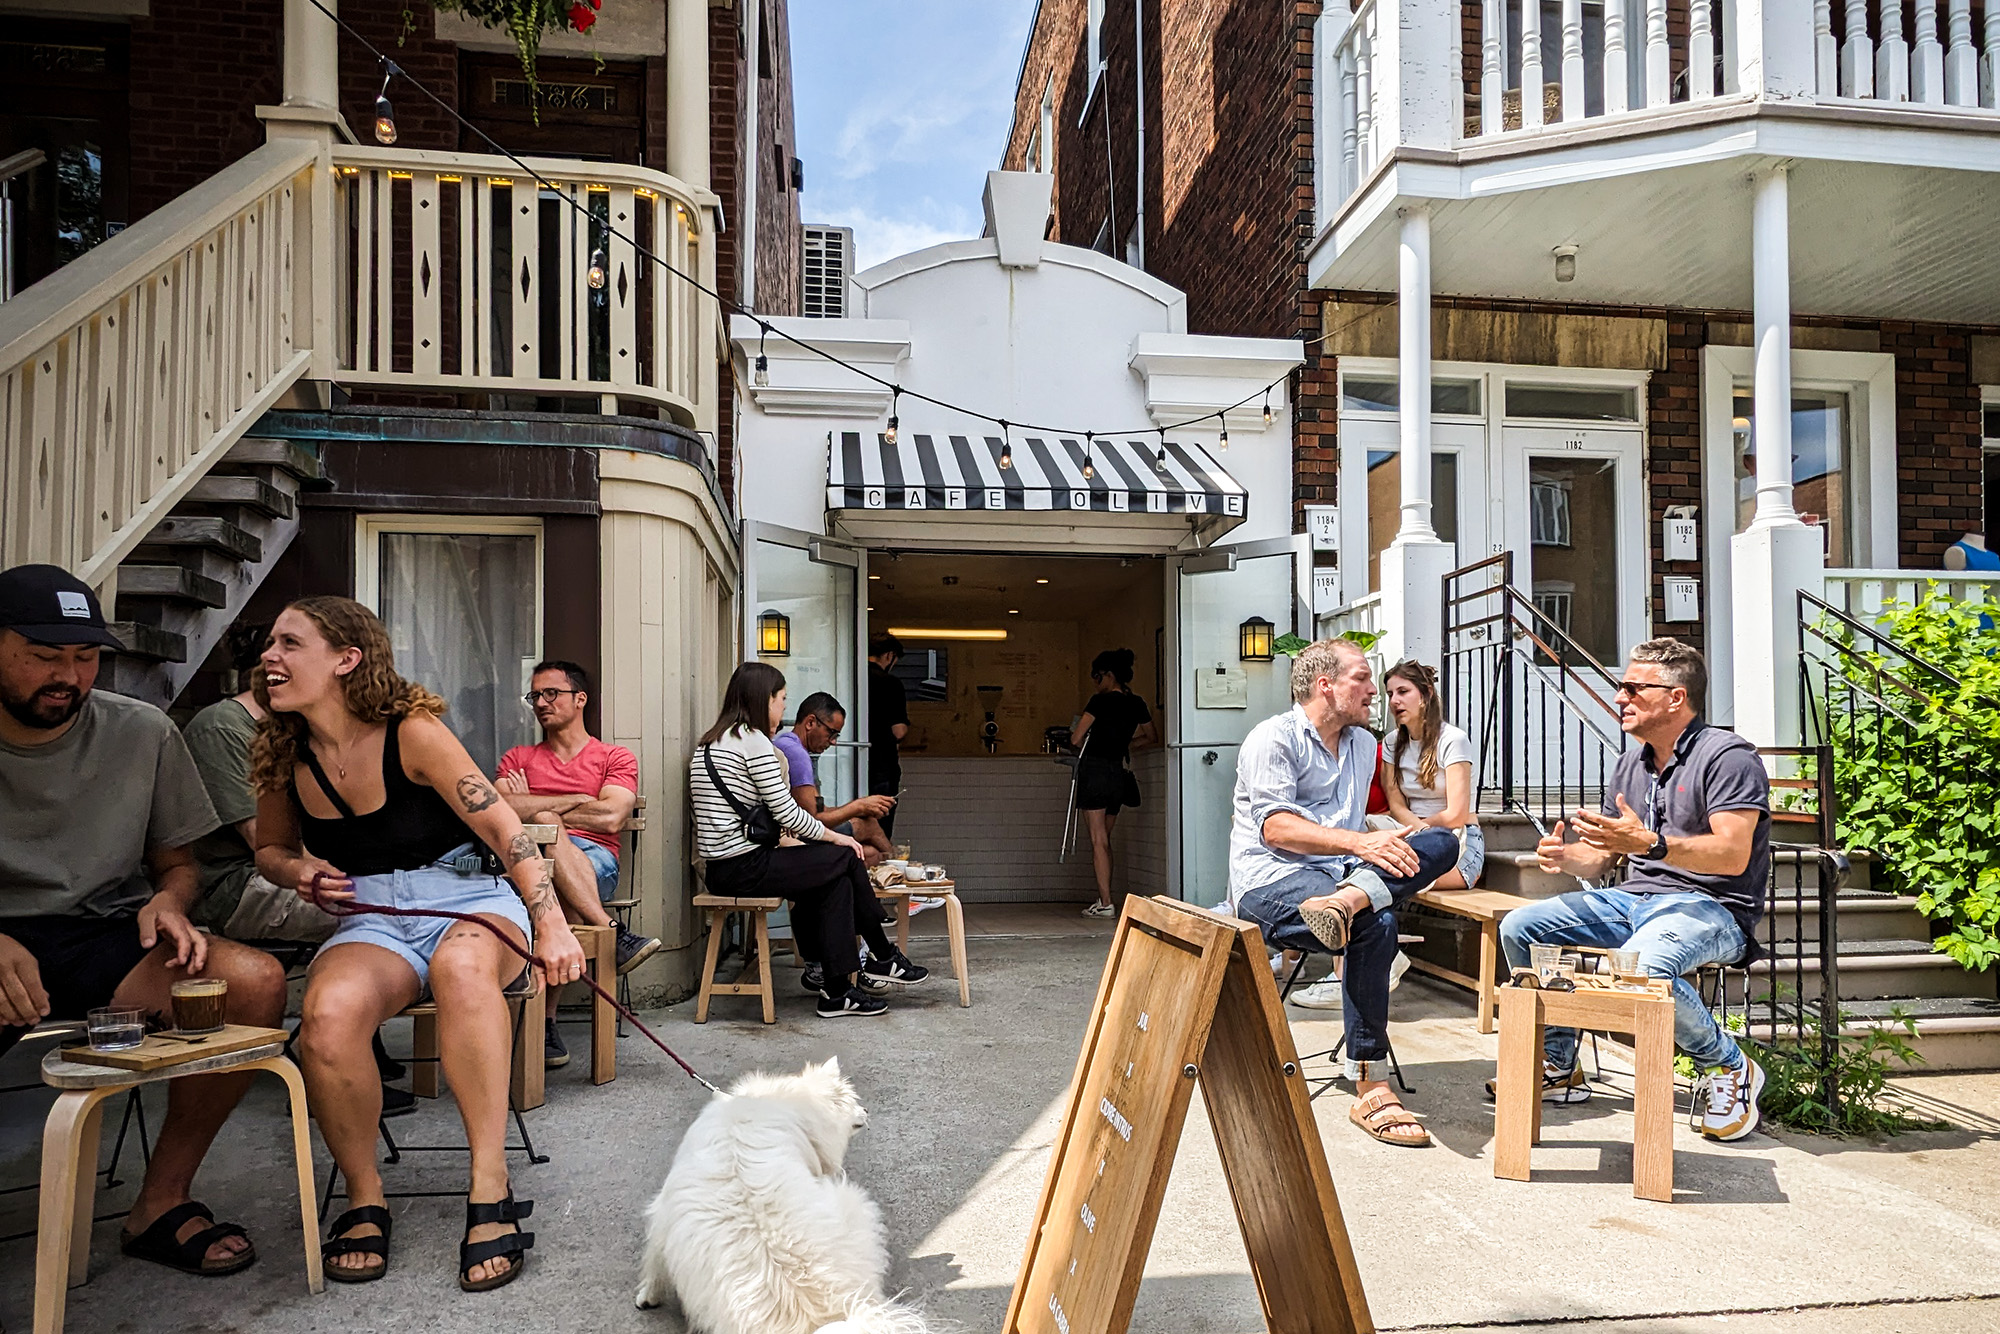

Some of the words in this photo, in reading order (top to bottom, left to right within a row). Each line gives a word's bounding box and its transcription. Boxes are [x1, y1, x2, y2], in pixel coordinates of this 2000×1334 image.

[1565, 440, 1583, 450] 1182
[868, 490, 1001, 507] CAFE
[1074, 491, 1239, 513] OLIVE
[1316, 515, 1335, 525] 1184
[1323, 524, 1329, 534] 2
[1675, 525, 1693, 535] 1182
[1682, 534, 1687, 544] 2
[1316, 577, 1335, 587] 1184
[1324, 587, 1329, 596] 1
[1676, 584, 1693, 594] 1182
[1683, 593, 1687, 603] 1
[1080, 1202, 1096, 1234] OLIVE
[1049, 1292, 1058, 1315] LA
